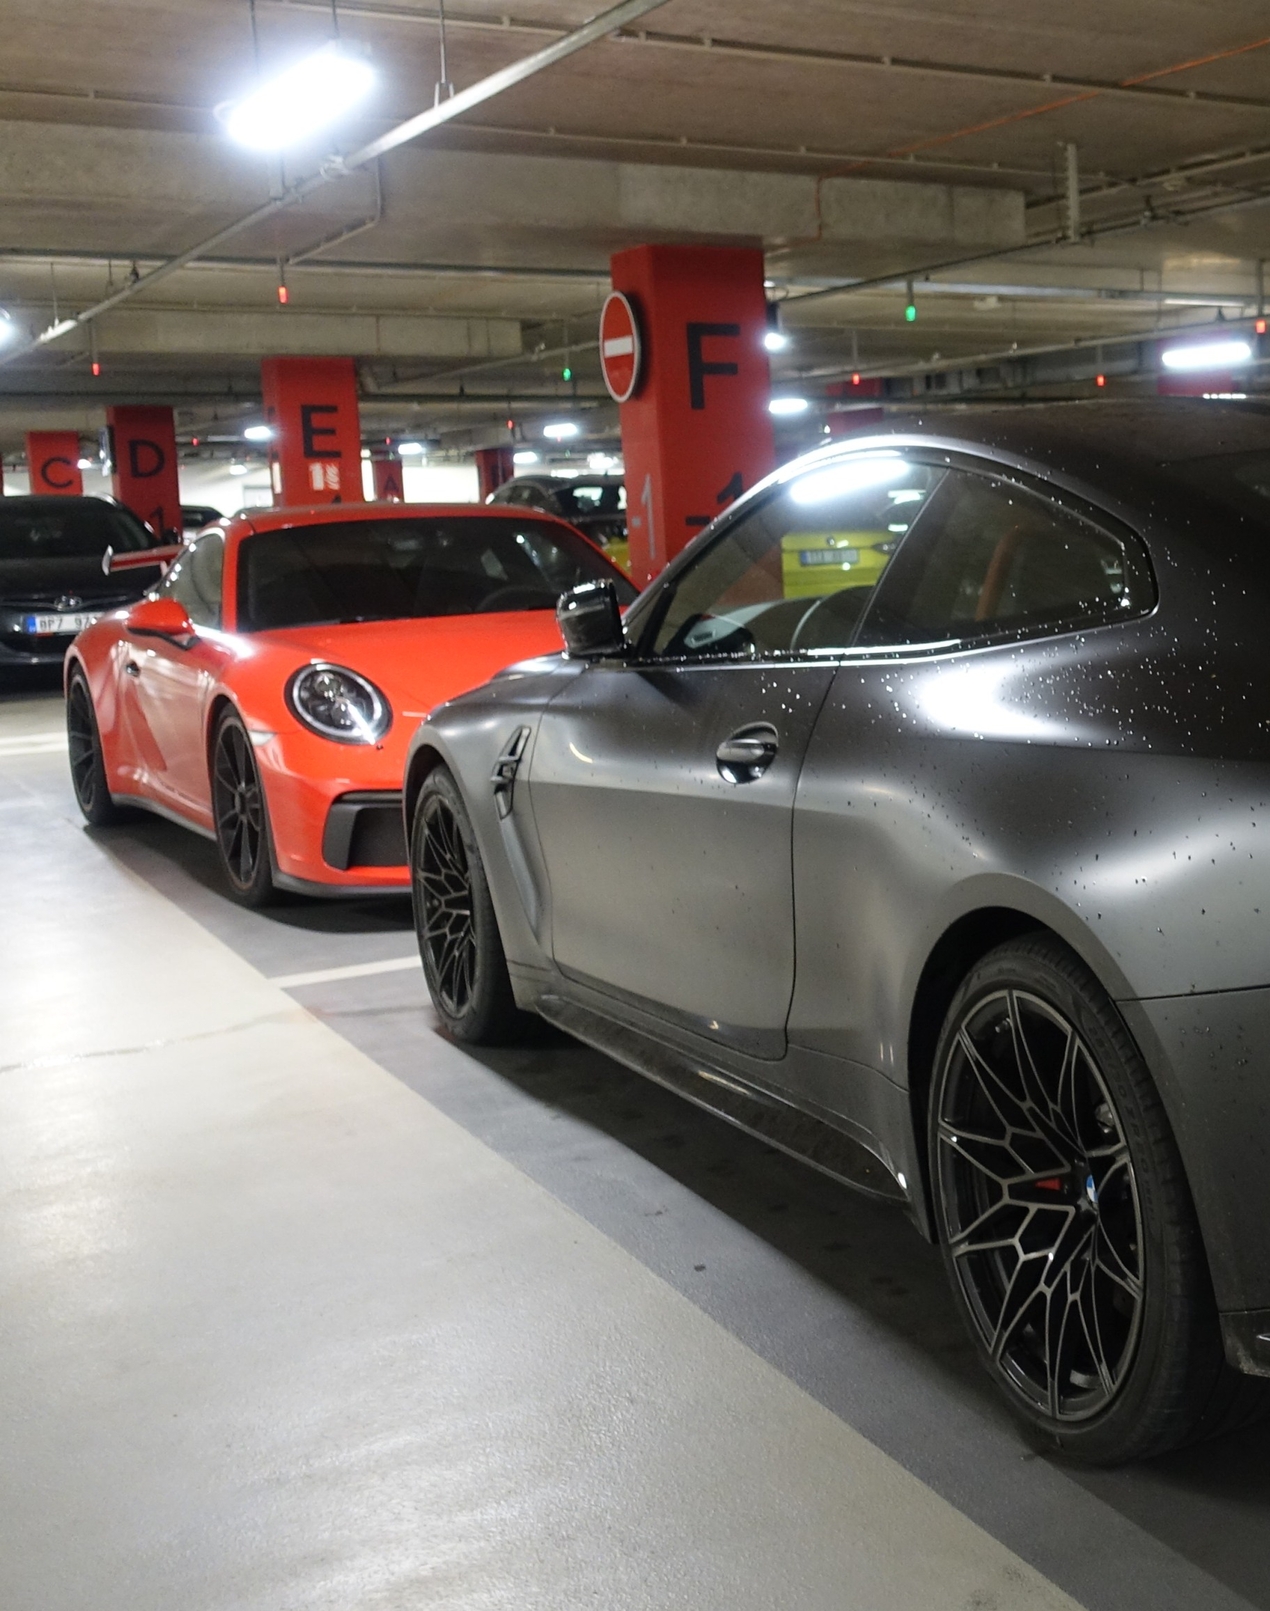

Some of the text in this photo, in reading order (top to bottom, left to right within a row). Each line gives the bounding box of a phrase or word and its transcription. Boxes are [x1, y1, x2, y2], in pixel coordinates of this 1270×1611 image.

[686, 322, 740, 410] F
[301, 404, 341, 458] E
[41, 457, 73, 488] C
[129, 439, 165, 478] D
[631, 473, 656, 560] -1
